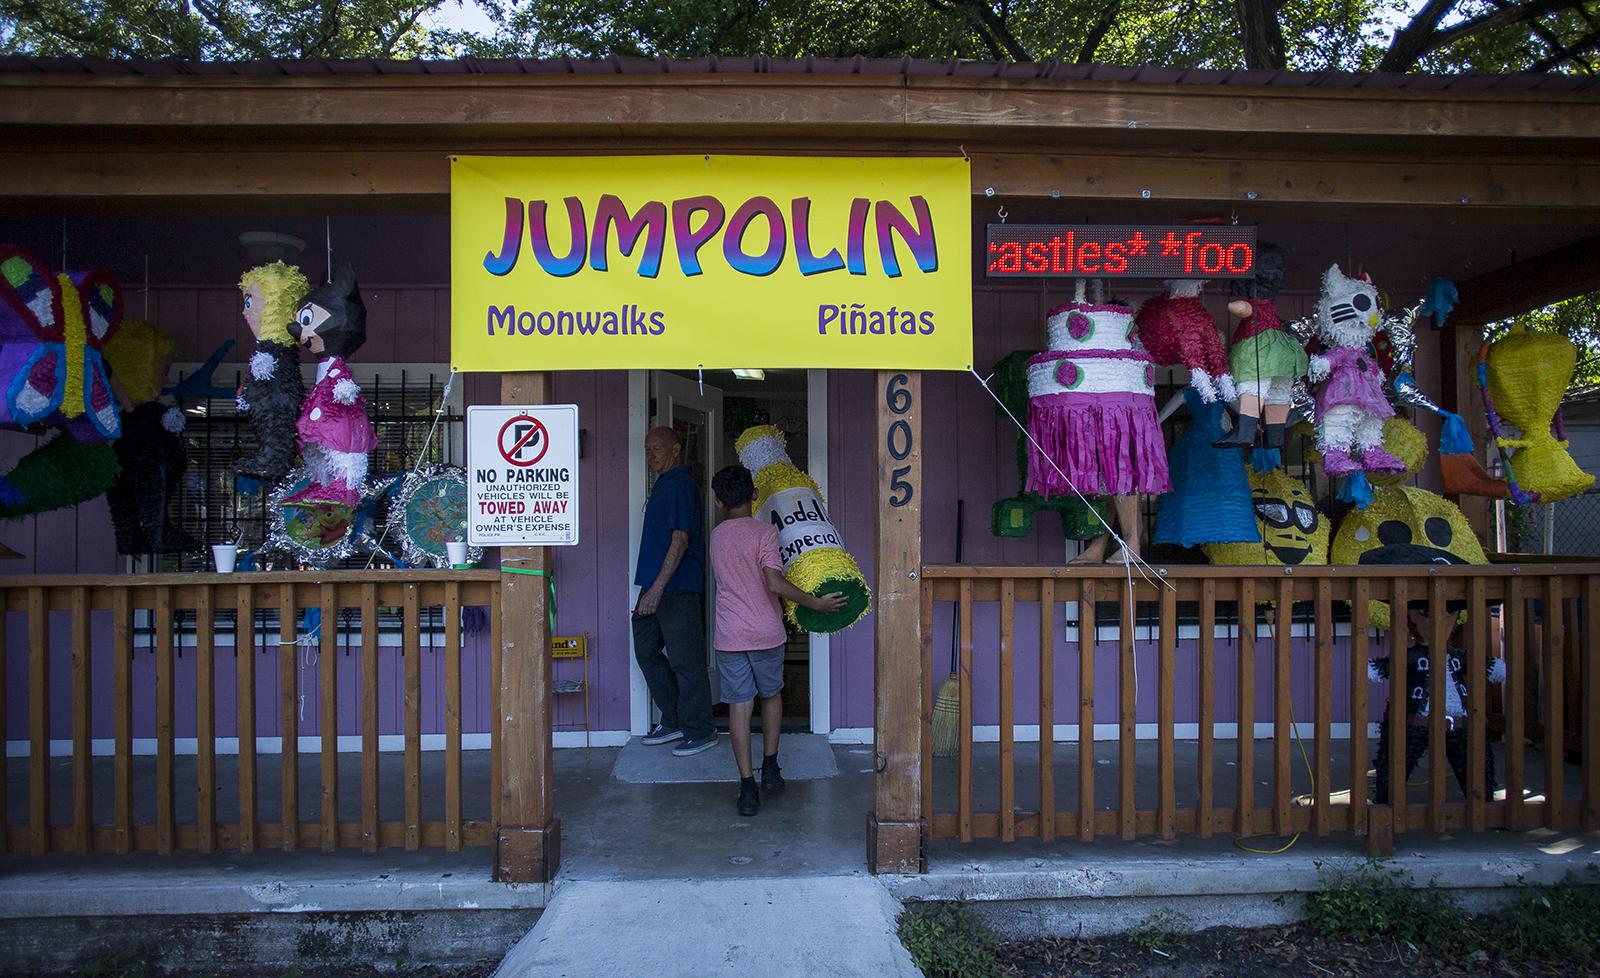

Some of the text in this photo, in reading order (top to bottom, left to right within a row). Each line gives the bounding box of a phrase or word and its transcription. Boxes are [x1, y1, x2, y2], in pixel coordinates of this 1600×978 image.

[482, 193, 939, 278] JUMPOLIN
[486, 304, 666, 337] Moonwalks
[817, 303, 936, 336] Piñatas
[886, 373, 914, 508] 605
[476, 468, 570, 483] NO PARKING
[485, 483, 561, 492] UNAUTHORIZED
[477, 491, 569, 500] VEHICLES WILL BE
[478, 500, 568, 515] TOWED AWAY
[770, 498, 833, 532] odel
[494, 515, 553, 523] AT VEHICLE
[475, 523, 571, 532] OWNER'S EXPENSE
